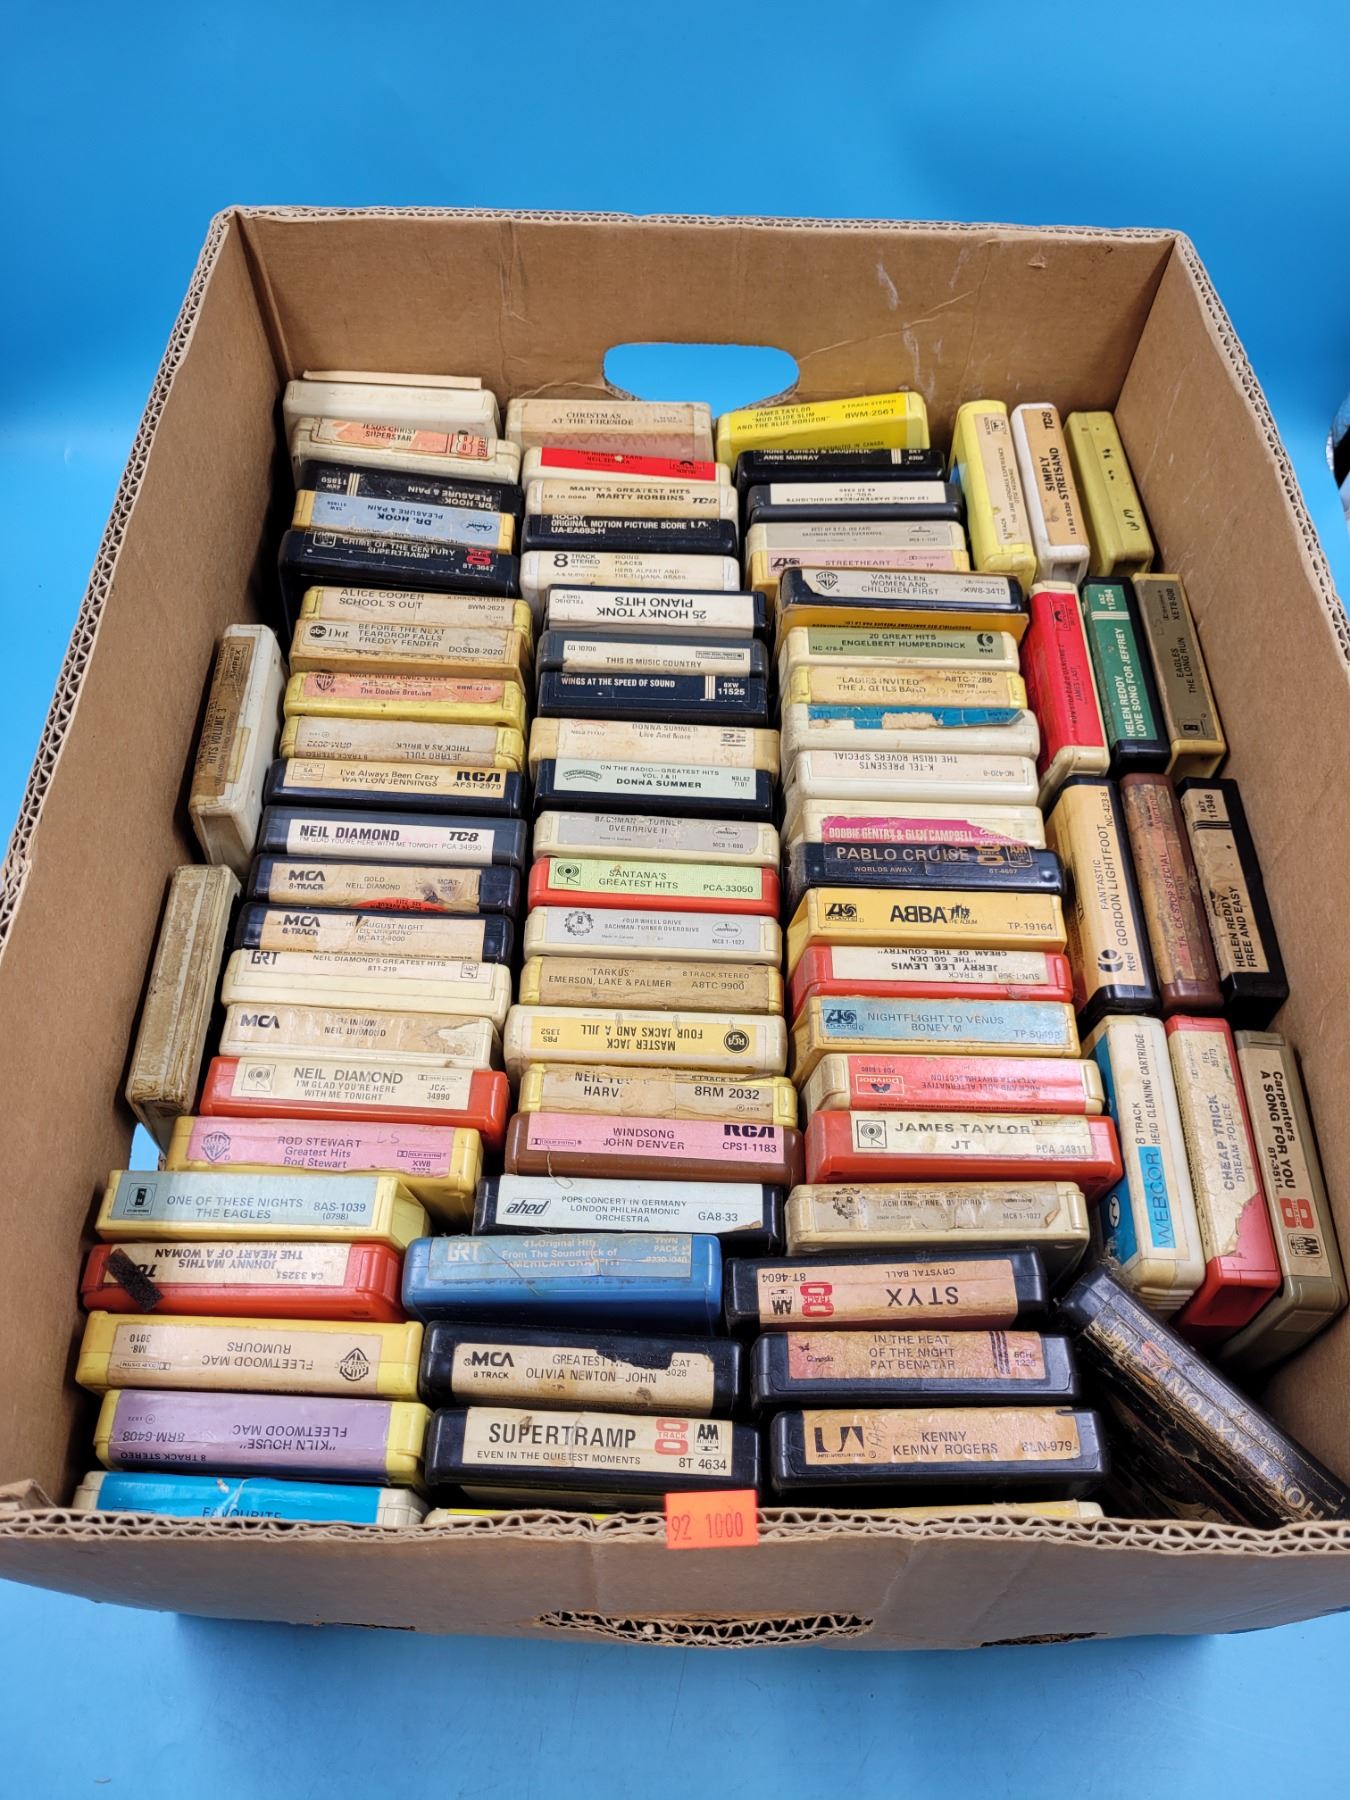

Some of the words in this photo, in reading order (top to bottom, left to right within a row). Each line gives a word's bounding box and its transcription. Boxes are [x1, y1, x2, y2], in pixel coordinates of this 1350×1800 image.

[781, 407, 811, 415] TAYLOR
[366, 431, 412, 442] SUPERSTAR
[1040, 456, 1056, 491] SIMPLY
[1049, 447, 1069, 500] STREISAND
[408, 486, 430, 495] PAIN
[433, 487, 440, 496] &
[443, 490, 492, 502] PLEASURE
[616, 487, 663, 495] GREATEST
[596, 493, 633, 501] MARTY
[377, 513, 409, 523] HOOK
[412, 517, 432, 526] DR.
[368, 549, 429, 560] SUPERTRAMP
[341, 589, 373, 598] ALICE
[379, 591, 424, 601] COOPER
[861, 586, 910, 594] CHILDREN
[914, 588, 939, 596] FIRST
[338, 598, 396, 609] SCHOOL'S
[399, 600, 424, 609] OUT
[615, 596, 646, 607] HITS
[649, 597, 694, 608] PIANO
[597, 607, 636, 618] TONK
[639, 609, 688, 619] HONKY
[693, 609, 707, 619] 25
[359, 637, 398, 645] FREDDY
[401, 639, 440, 648] FENDER
[842, 639, 896, 648] ENGELBERT
[899, 641, 966, 649] HUMPERDINCK
[1177, 637, 1190, 655] RUN
[1171, 647, 1185, 678] EAGLES
[1182, 655, 1195, 677] LONG
[561, 677, 586, 686] WINGS
[587, 678, 597, 686] AT
[598, 678, 613, 686] THE
[614, 679, 638, 687] SPEED
[639, 679, 648, 688] OF
[650, 680, 676, 688] SOUND
[1187, 677, 1197, 694] THE
[717, 687, 746, 696] 11525
[1114, 675, 1129, 704] REDDY
[1121, 704, 1136, 737] HELEN
[207, 743, 218, 765] HITS
[213, 714, 225, 742] VOLUME
[832, 752, 871, 761] SPECIAL
[875, 754, 909, 762] ROVERS
[911, 755, 937, 763] IRISH
[941, 755, 958, 763] THE
[859, 762, 905, 770] PRESENTS
[910, 763, 934, 771] K-TEL
[342, 776, 384, 784] WAYLON
[387, 779, 438, 787] JENNINGS
[457, 771, 501, 782] RCA
[616, 778, 653, 787] DONNA
[655, 781, 702, 789] SUMMER
[1206, 793, 1218, 818] 11348
[300, 825, 328, 838] NEIL
[335, 827, 400, 842] DIAMOND
[449, 831, 479, 842] TC8
[836, 846, 898, 861] PABLO
[902, 847, 970, 862] CRUISE
[1097, 824, 1118, 890] LIGHTFOOT
[289, 871, 325, 882] MCA
[609, 869, 667, 880] SANTANA'S
[599, 878, 652, 889] GREATEST
[655, 881, 679, 890] HITS
[703, 884, 754, 893] PCA-33050
[1093, 859, 1109, 910] FANTASTIC
[890, 905, 948, 924] ABBA
[1219, 895, 1236, 930] REDDY
[283, 915, 320, 927] MCA
[1110, 893, 1129, 947] GORDON
[1008, 922, 1053, 931] TP-19164
[1228, 933, 1245, 968] HELEN
[251, 951, 280, 965] GRT
[587, 967, 635, 977] "TARKUS"
[891, 962, 929, 970] LEWIS
[934, 963, 957, 971] LEE
[963, 964, 998, 972] JERRY
[240, 1014, 280, 1029] MCA
[868, 1012, 945, 1024] NIGHTFLIGHT
[948, 1014, 963, 1024] TO
[966, 1015, 1004, 1025] VENUS
[607, 1040, 632, 1050] JACK
[636, 1041, 676, 1051] MASTER
[1134, 1033, 1151, 1077] CARTRIDGE
[294, 1067, 325, 1081] NEIL
[334, 1070, 404, 1085] DIAMOND
[1142, 1079, 1156, 1118] CLEANING
[1272, 1071, 1296, 1143] Carpenters
[1208, 1094, 1225, 1138] TRICK
[613, 1128, 675, 1139] WINDSONG
[724, 1124, 775, 1138] RCA
[895, 1123, 955, 1133] JAMES
[961, 1123, 1031, 1135] TAYLOR
[1149, 1119, 1161, 1145] HEAD
[277, 1136, 303, 1146] ROD
[305, 1137, 363, 1149] STEWART
[603, 1138, 633, 1148] JOHN
[637, 1140, 685, 1151] DENVER
[722, 1141, 777, 1153] CPS1-1183
[285, 1147, 327, 1158] Greatest
[330, 1149, 352, 1158] Hits
[1215, 1141, 1235, 1191] CHEAP
[562, 1196, 582, 1204] POPS
[585, 1197, 626, 1205] CONCERT
[642, 1199, 687, 1208] GERMANY
[1146, 1149, 1169, 1245] WEBCOR
[313, 1201, 366, 1213] 8AS-1039
[571, 1205, 608, 1213] LONDON
[611, 1206, 680, 1216] PHILHARMONIC
[196, 1208, 220, 1218] THE
[223, 1209, 271, 1219] EAGLES
[596, 1214, 650, 1224] ORCHESTRA
[698, 1211, 738, 1222] GA8-33
[178, 1258, 226, 1269] MATHIS
[229, 1259, 276, 1271] JOHNNY
[884, 1271, 909, 1279] BALL
[912, 1268, 956, 1278] CRYSTAL
[886, 1286, 959, 1307] STYX
[226, 1341, 292, 1354] RUMOURS
[201, 1354, 231, 1367] MAC
[236, 1355, 313, 1371] FLEETWOOD
[472, 1351, 514, 1367] MCA
[553, 1354, 606, 1366] GREATEST
[870, 1360, 895, 1370] PAT
[898, 1360, 957, 1370] BENATAR
[526, 1367, 566, 1379] OLIVIA
[570, 1370, 657, 1384] NEWTON-JOHN
[232, 1424, 263, 1436] MAC
[267, 1425, 348, 1438] FLEETWOOD
[489, 1422, 637, 1449] SUPERTRAMP
[239, 1438, 293, 1451] HOUSE"
[297, 1439, 336, 1452] "KILN
[892, 1444, 939, 1456] KENNY
[944, 1443, 999, 1455] ROGERS
[678, 1458, 693, 1468] 8T
[698, 1458, 727, 1470] 4634
[706, 1511, 744, 1539] 1000
